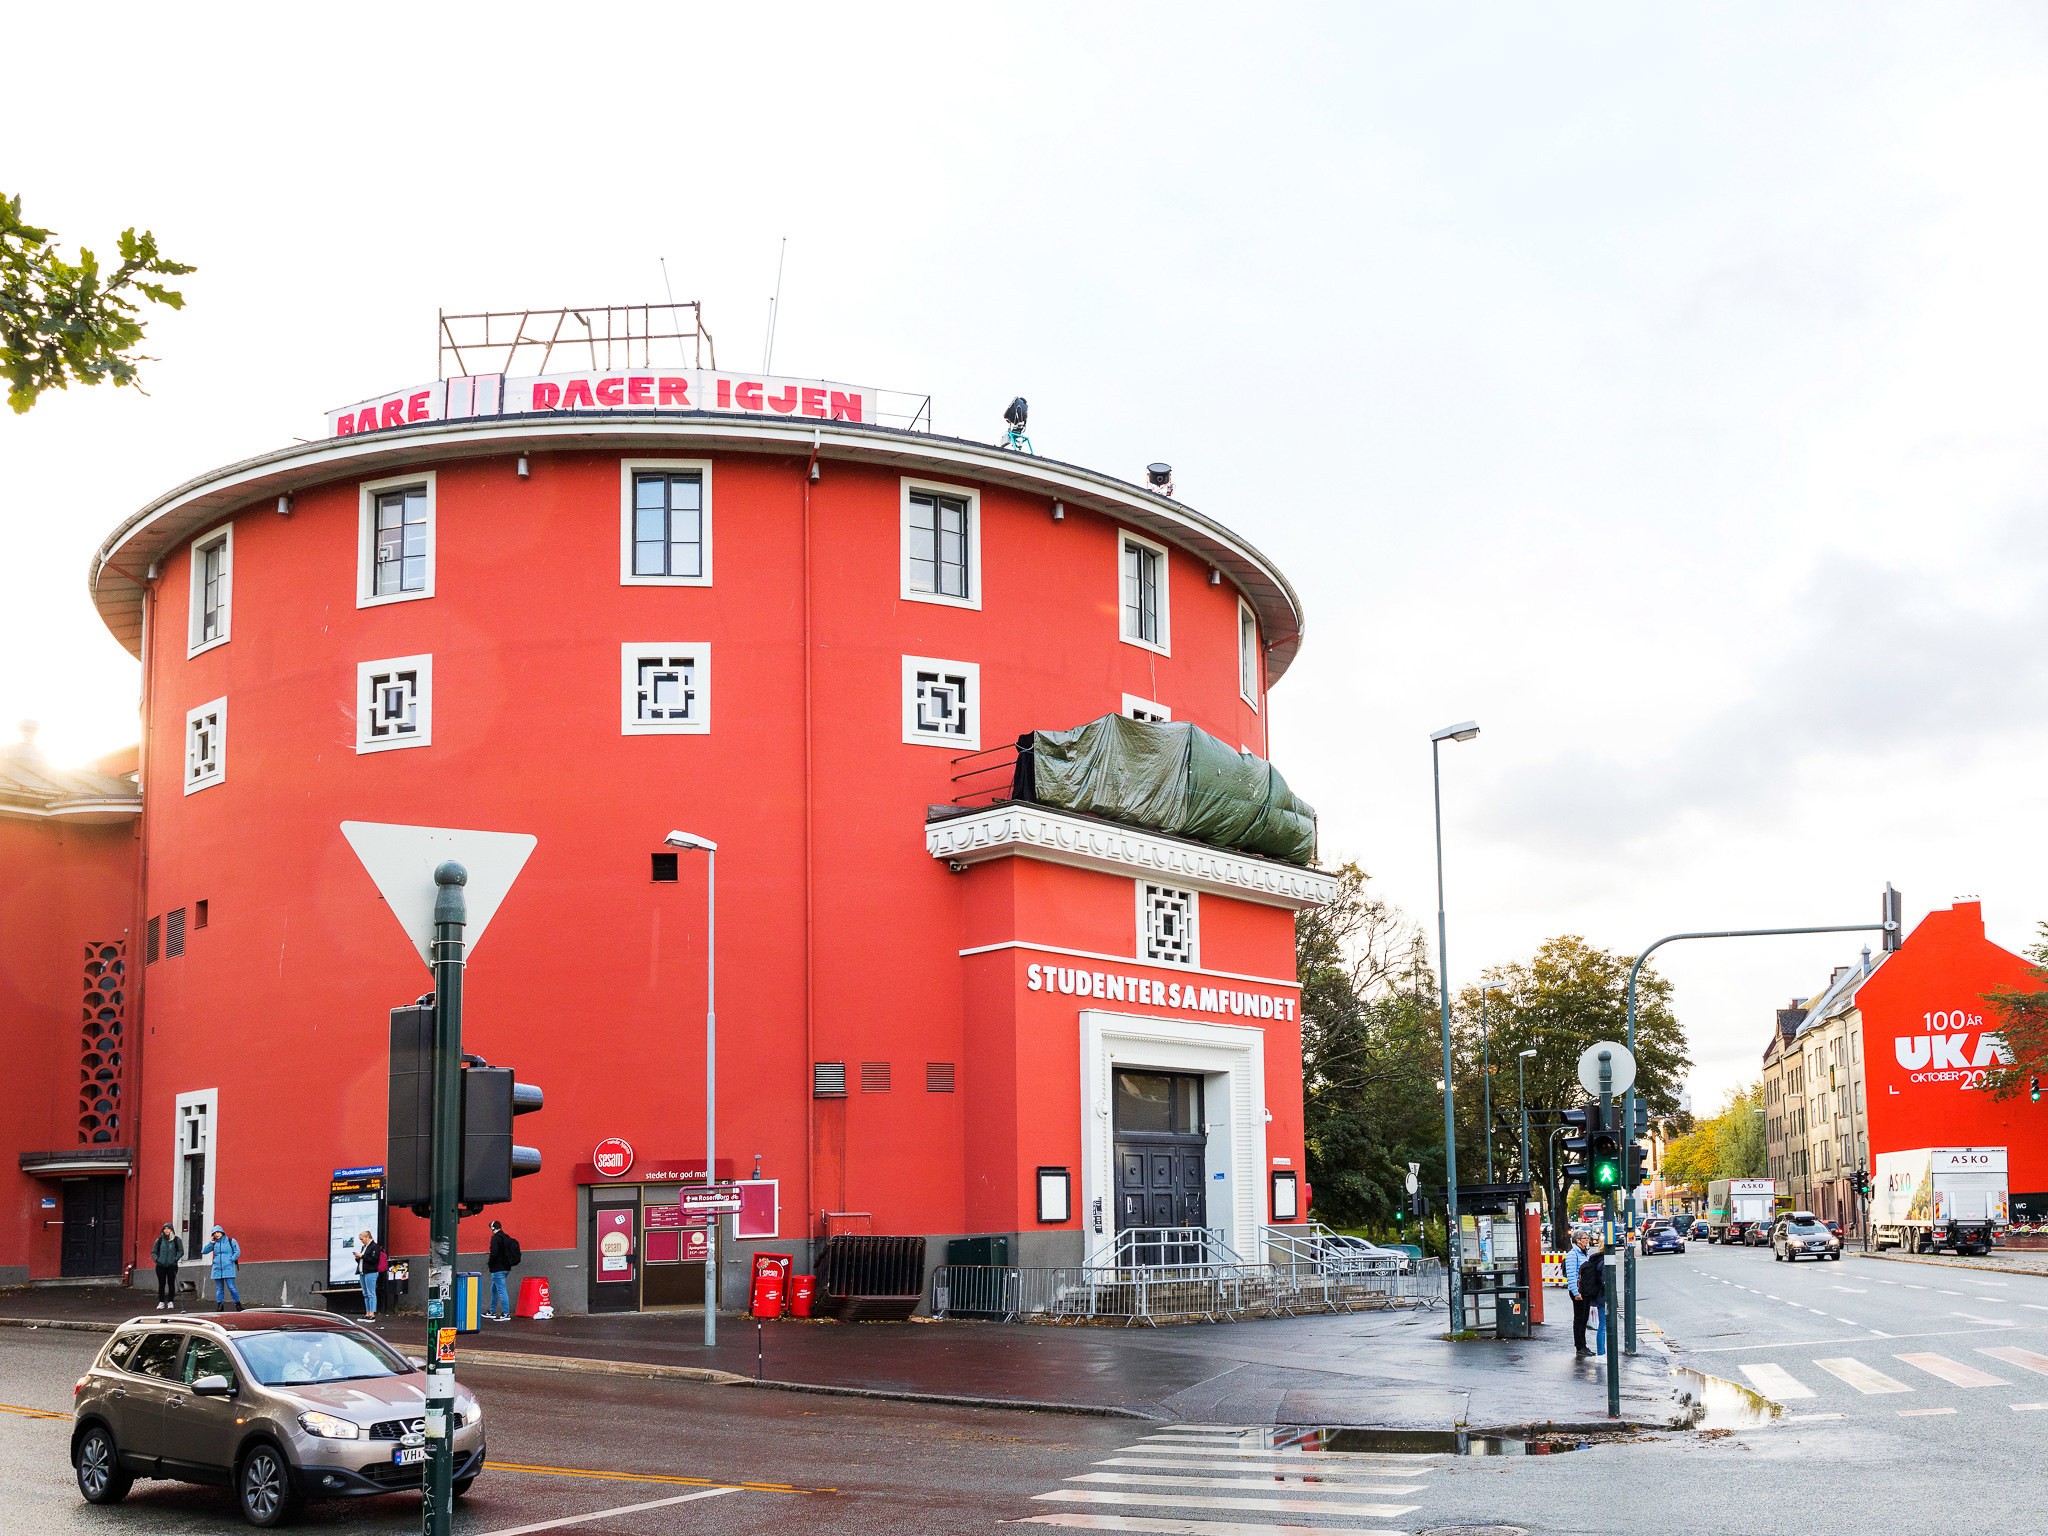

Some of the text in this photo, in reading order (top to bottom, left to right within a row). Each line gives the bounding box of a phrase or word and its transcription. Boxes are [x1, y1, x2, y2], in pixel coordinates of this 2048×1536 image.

[336, 376, 864, 437] BARE DAGER IGJEN
[1027, 963, 1296, 1022] STUDENTERSAMFUNDET
[1923, 1010, 1983, 1032] 100 ÅR
[1894, 1031, 2018, 1071] UKA
[1910, 1071, 1959, 1083] OKTOBER
[598, 1153, 623, 1168] sesam
[1951, 1155, 1989, 1164] ASKO
[342, 1167, 383, 1176] Studentersamfundet
[646, 1170, 708, 1180] stedet for god mat
[1889, 1172, 1911, 1192] ASKO
[604, 1242, 622, 1253] sesam
